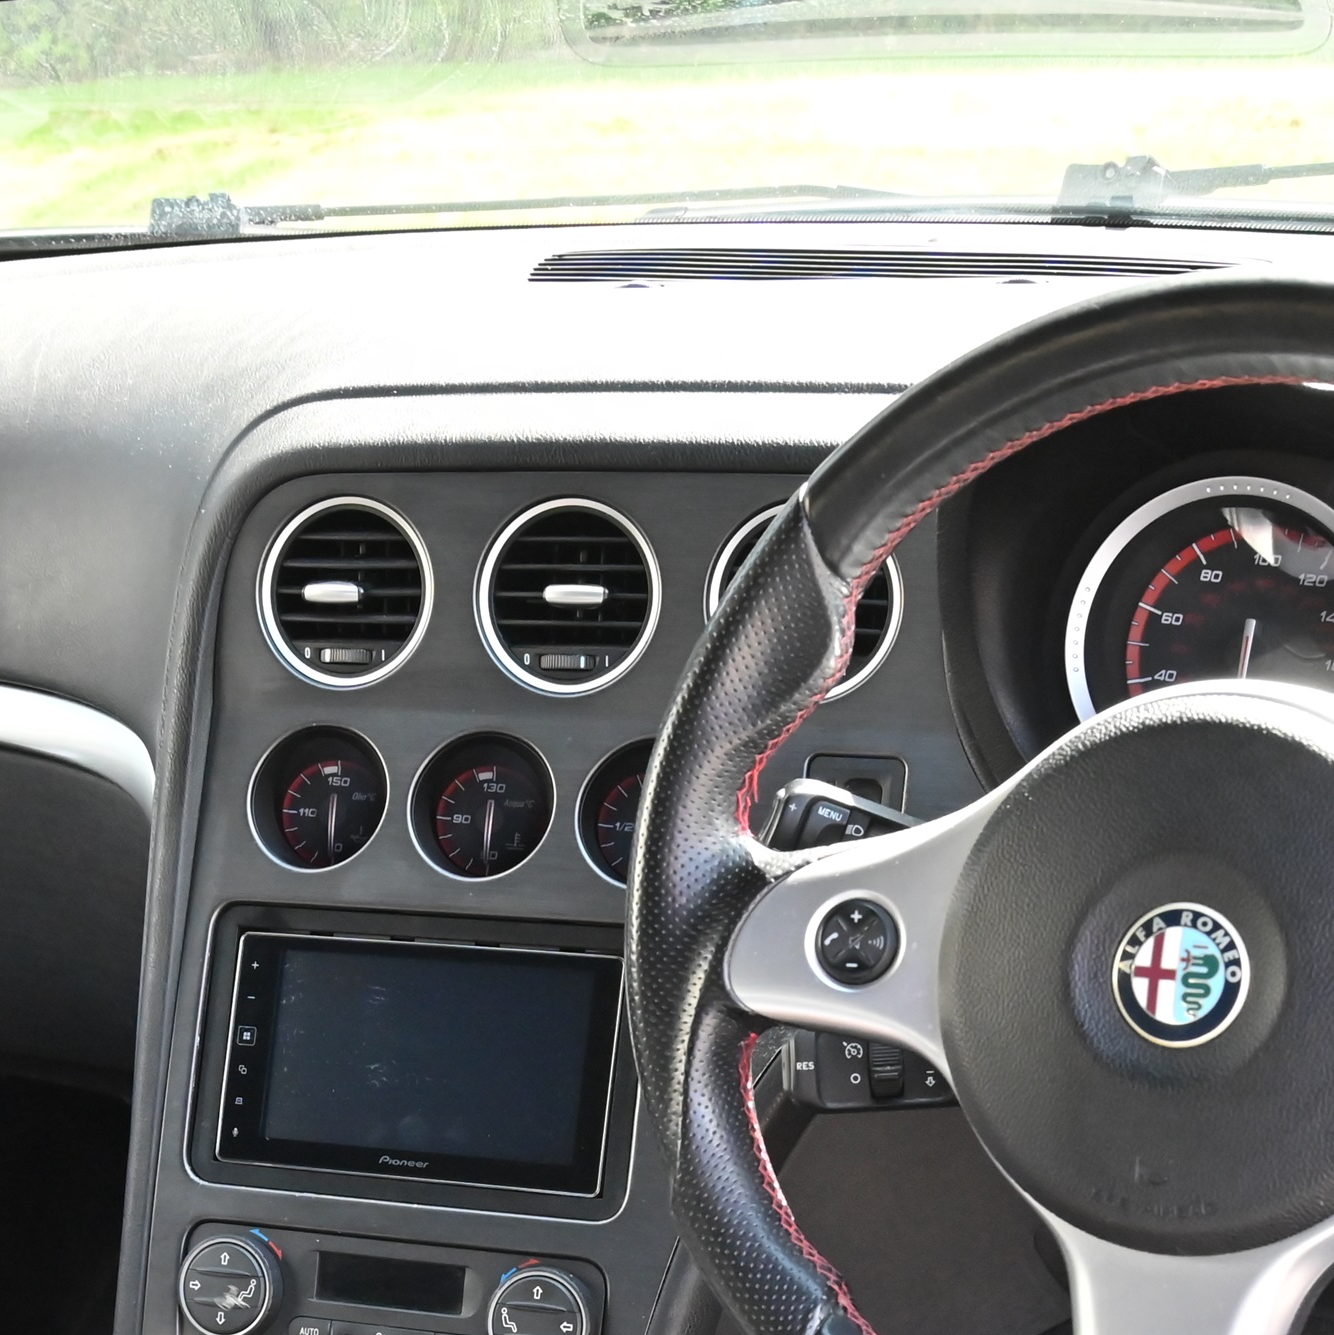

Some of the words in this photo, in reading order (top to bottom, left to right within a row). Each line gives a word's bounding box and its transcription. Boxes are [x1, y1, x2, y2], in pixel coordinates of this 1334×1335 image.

[1253, 553, 1282, 567] 100
[1199, 569, 1223, 583] 80
[1298, 572, 1328, 588] 120
[1161, 612, 1184, 626] 60
[1153, 669, 1177, 683] 40
[327, 776, 351, 787] 150
[483, 783, 506, 793] 130
[298, 807, 318, 817] 110
[452, 814, 471, 824] 90
[817, 805, 843, 822] MENU
[614, 821, 634, 832] 1/2
[1118, 916, 1167, 974] ALFA
[1180, 911, 1242, 983] ROMEO
[796, 1061, 815, 1071] RES
[378, 1154, 430, 1169] Pioneer
